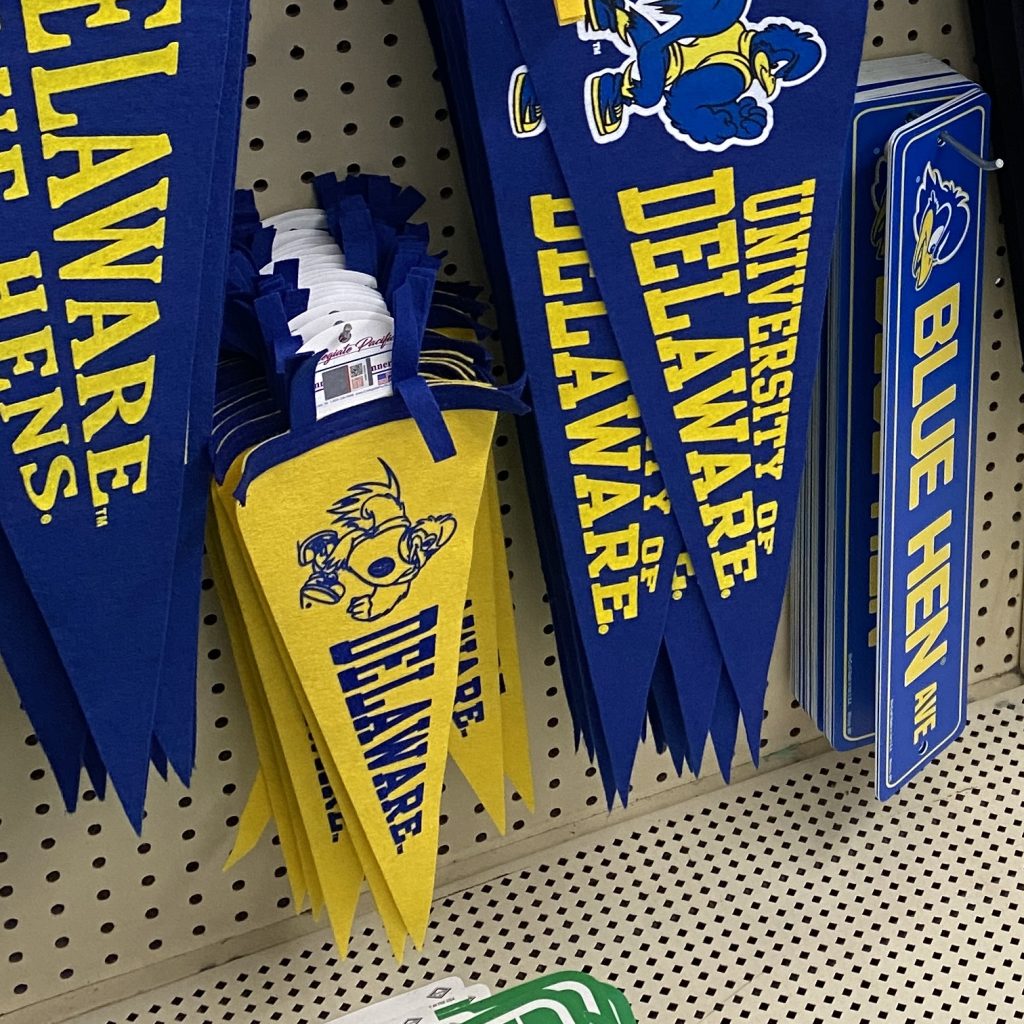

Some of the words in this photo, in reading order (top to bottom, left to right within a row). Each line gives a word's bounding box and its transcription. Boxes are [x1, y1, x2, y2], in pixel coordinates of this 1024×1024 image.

[617, 166, 757, 593] DELAWARE
[742, 178, 816, 481] UNIVERSITY
[908, 282, 960, 512] BLUE
[639, 534, 665, 594] OF
[756, 499, 779, 555] OF
[904, 509, 953, 687] HEN
[329, 604, 440, 846] DELAWARE
[913, 681, 938, 746] AVE
